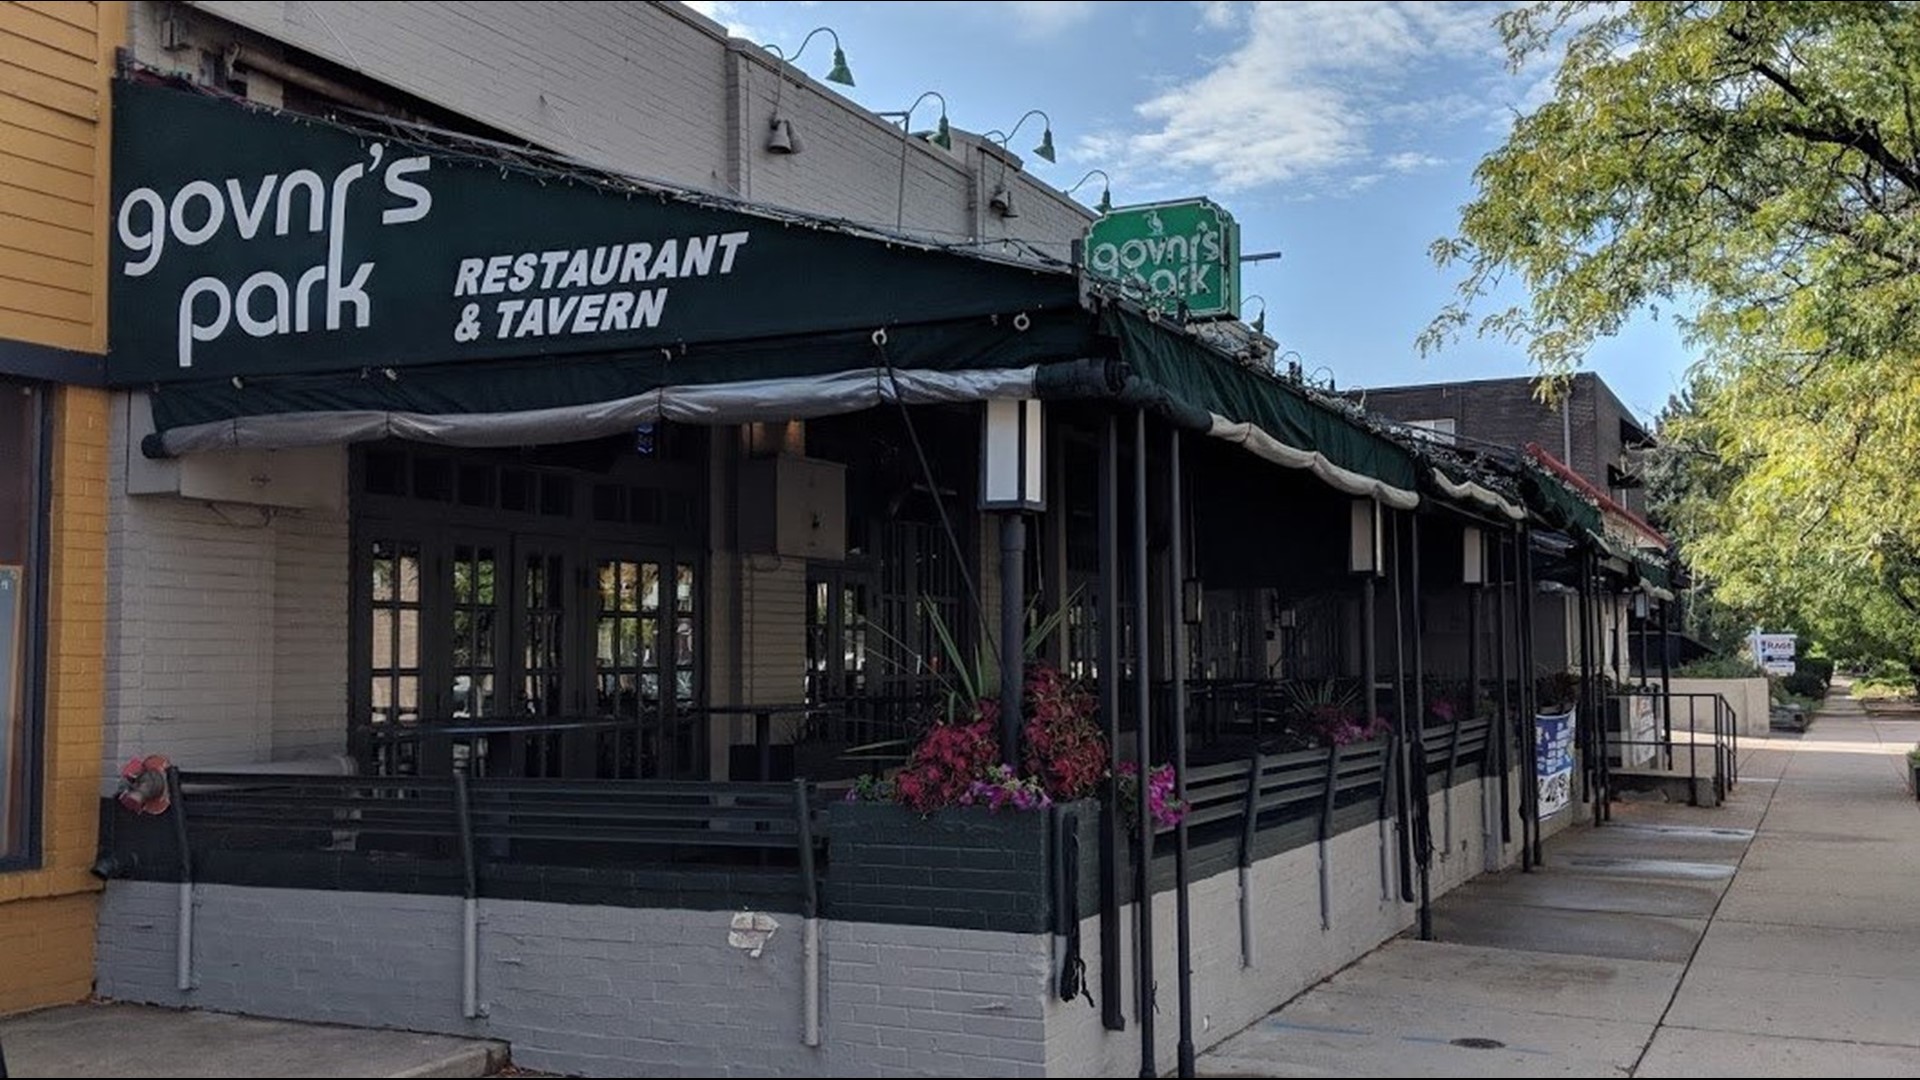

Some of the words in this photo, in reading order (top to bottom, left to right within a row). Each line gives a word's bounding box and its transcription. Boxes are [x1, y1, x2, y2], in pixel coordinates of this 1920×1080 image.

[117, 142, 433, 277] govnr's
[452, 231, 749, 297] RESTAURANT
[178, 262, 375, 367] park
[453, 302, 481, 343] &
[495, 288, 668, 340] TAVERN
